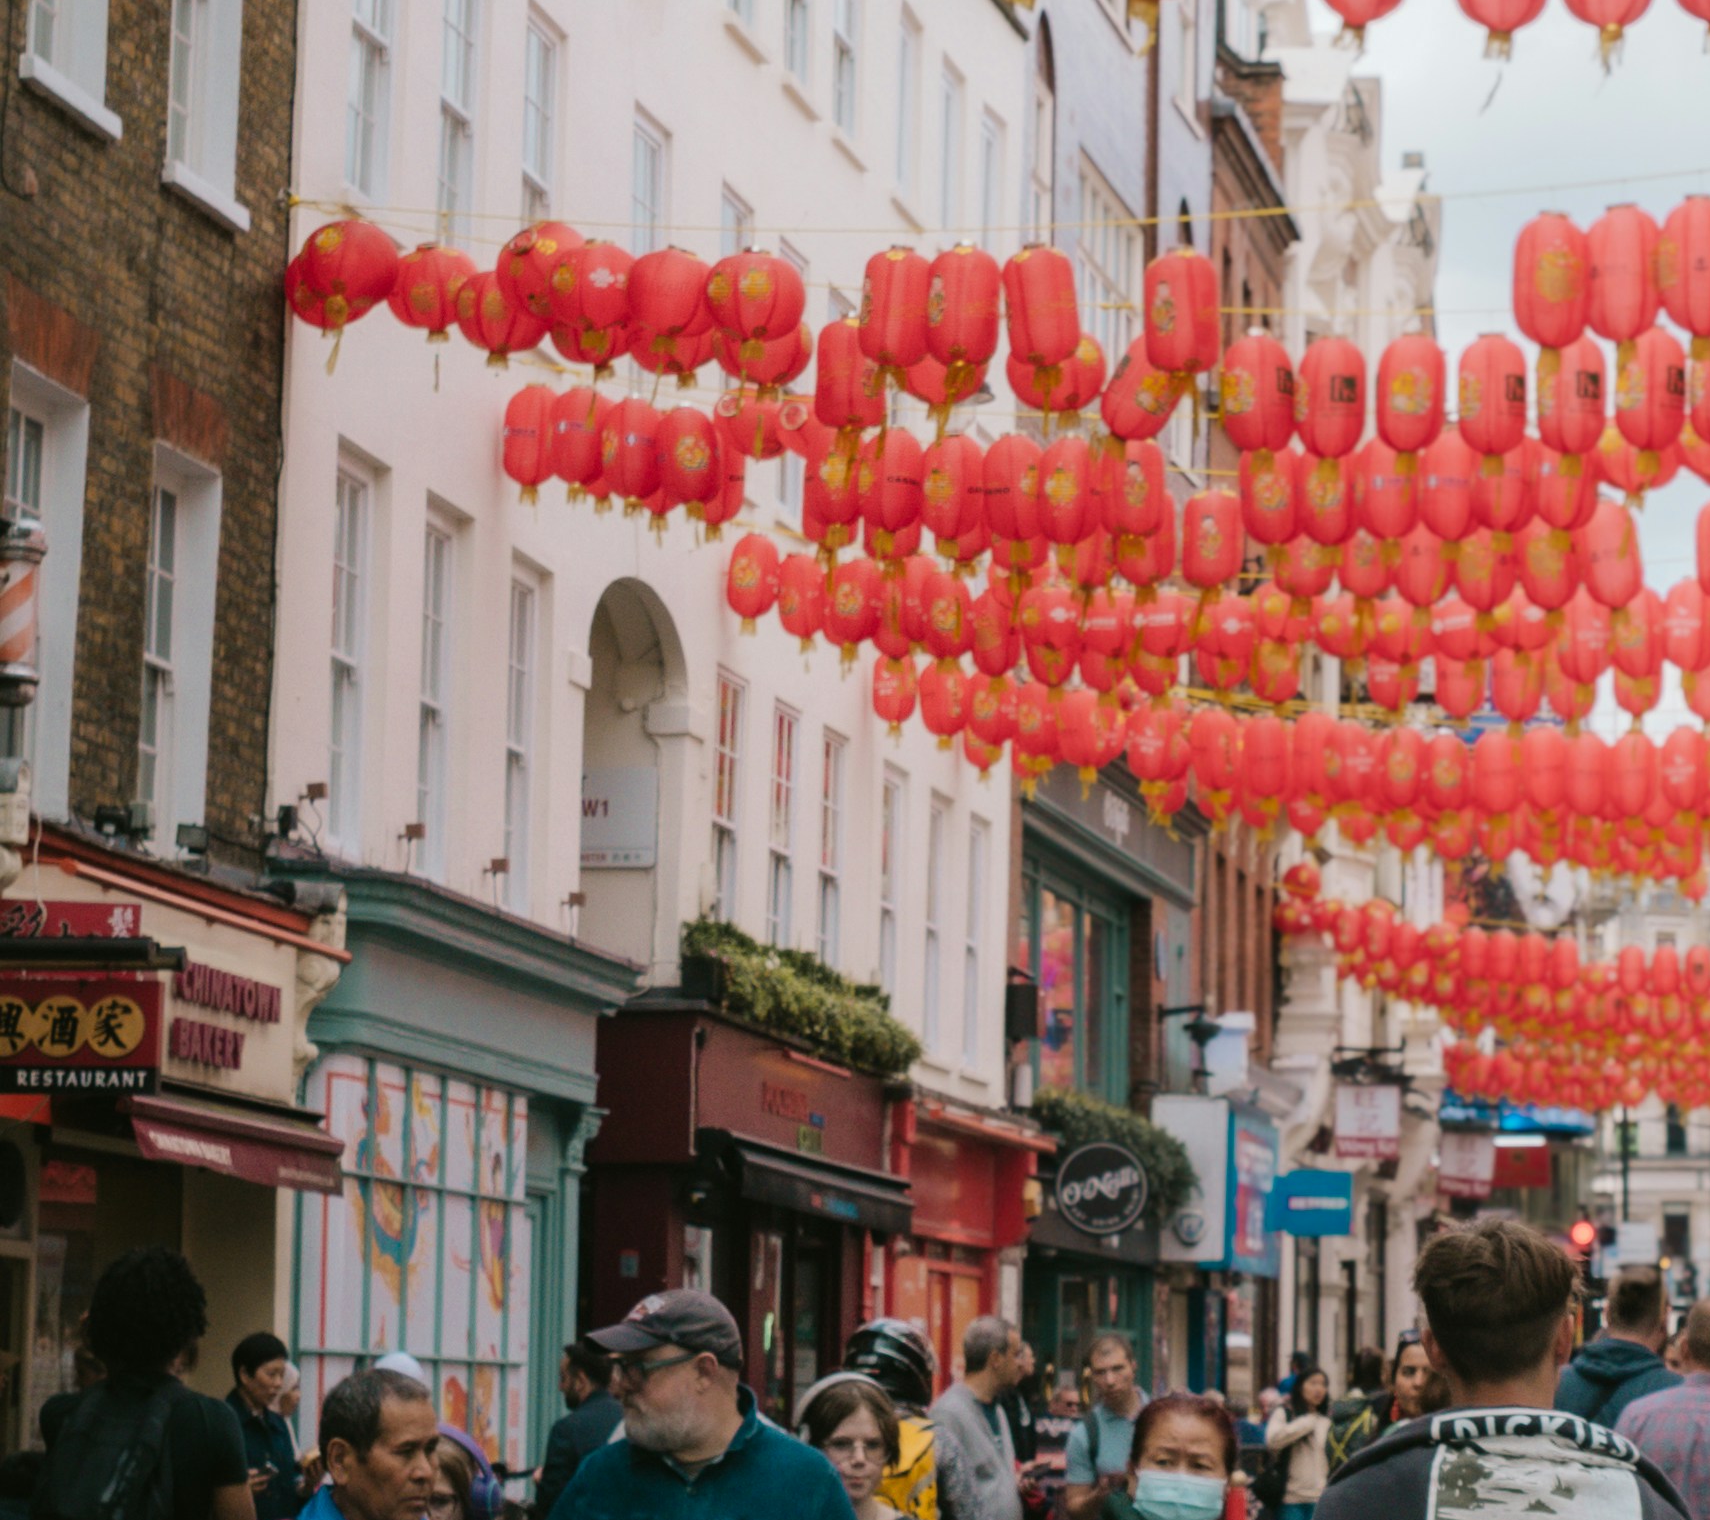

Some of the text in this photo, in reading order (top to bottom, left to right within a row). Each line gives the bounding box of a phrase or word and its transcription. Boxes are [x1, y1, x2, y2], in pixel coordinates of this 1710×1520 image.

[174, 960, 281, 1024] CHINATOWN
[170, 1017, 246, 1070] BAKERY
[17, 1069, 147, 1087] RESTAURANT
[1454, 1415, 1628, 1461] DICKIES
